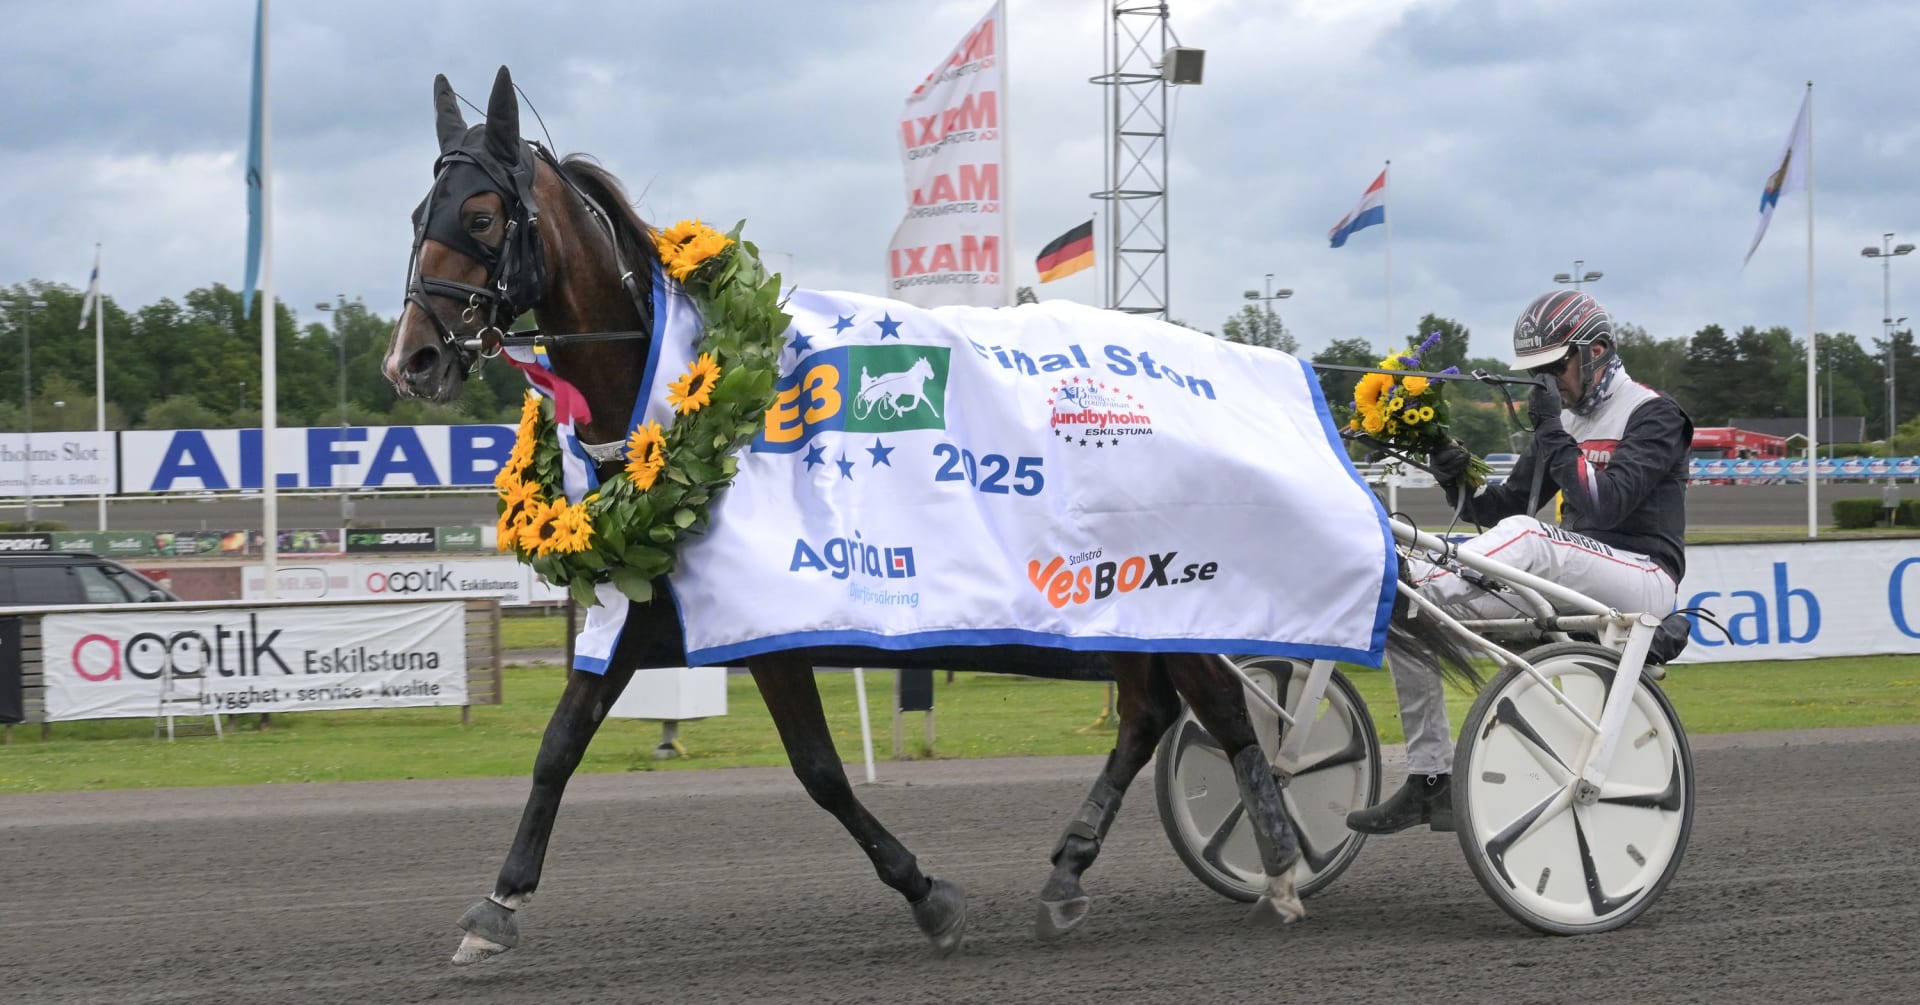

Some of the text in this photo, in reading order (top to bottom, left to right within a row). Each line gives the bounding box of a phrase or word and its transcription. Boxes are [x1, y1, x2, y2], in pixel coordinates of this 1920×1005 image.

[1103, 344, 1216, 400] Ston
[764, 363, 842, 444] E3
[1085, 428, 1153, 436] ESKILSTUNA
[933, 442, 1044, 497] 2025
[789, 529, 883, 580] Agria
[1069, 547, 1103, 566] Stallströ
[461, 580, 519, 591] Eskilstuna
[304, 647, 440, 675] Eskilstuna
[297, 683, 363, 701] service
